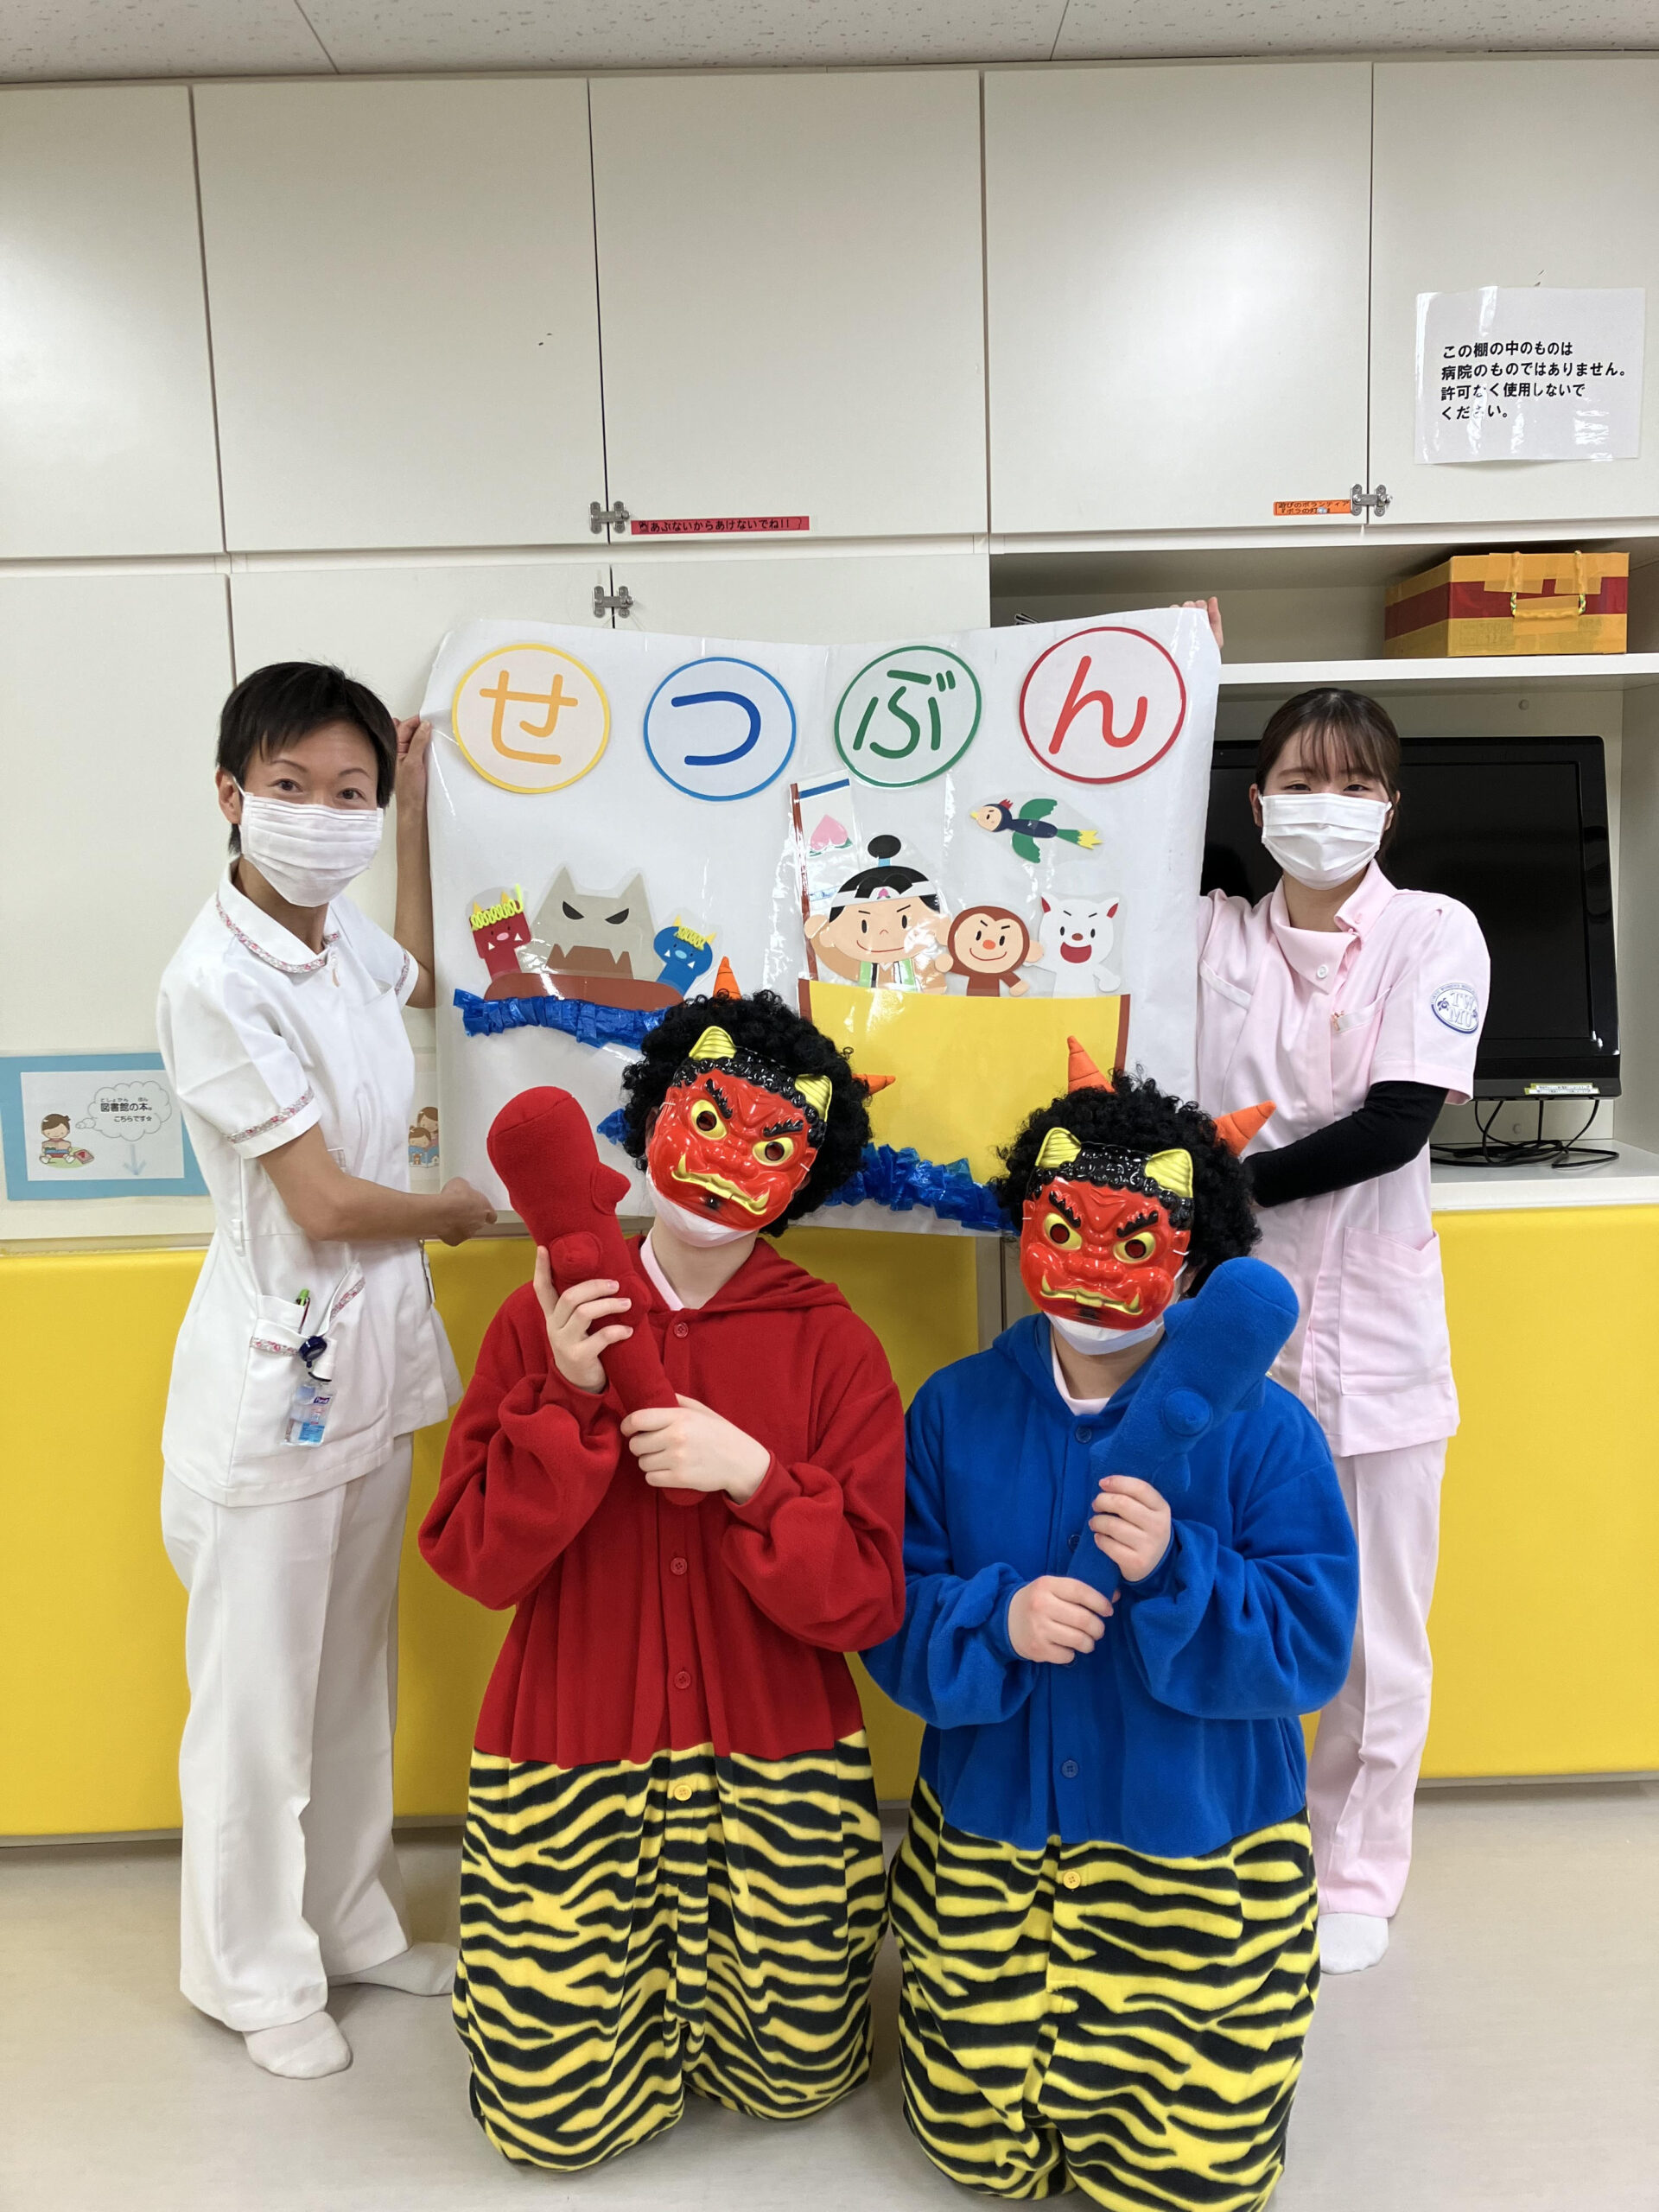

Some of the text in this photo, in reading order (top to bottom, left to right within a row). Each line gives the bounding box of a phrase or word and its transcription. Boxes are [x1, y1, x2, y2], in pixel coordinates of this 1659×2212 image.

[1443, 340, 1573, 359] この棚の中のものは
[1441, 362, 1626, 380] 病院のものではありません。
[1440, 383, 1586, 401] 許可なく使用しないで
[100, 1103, 152, 1112] 図書館の本。
